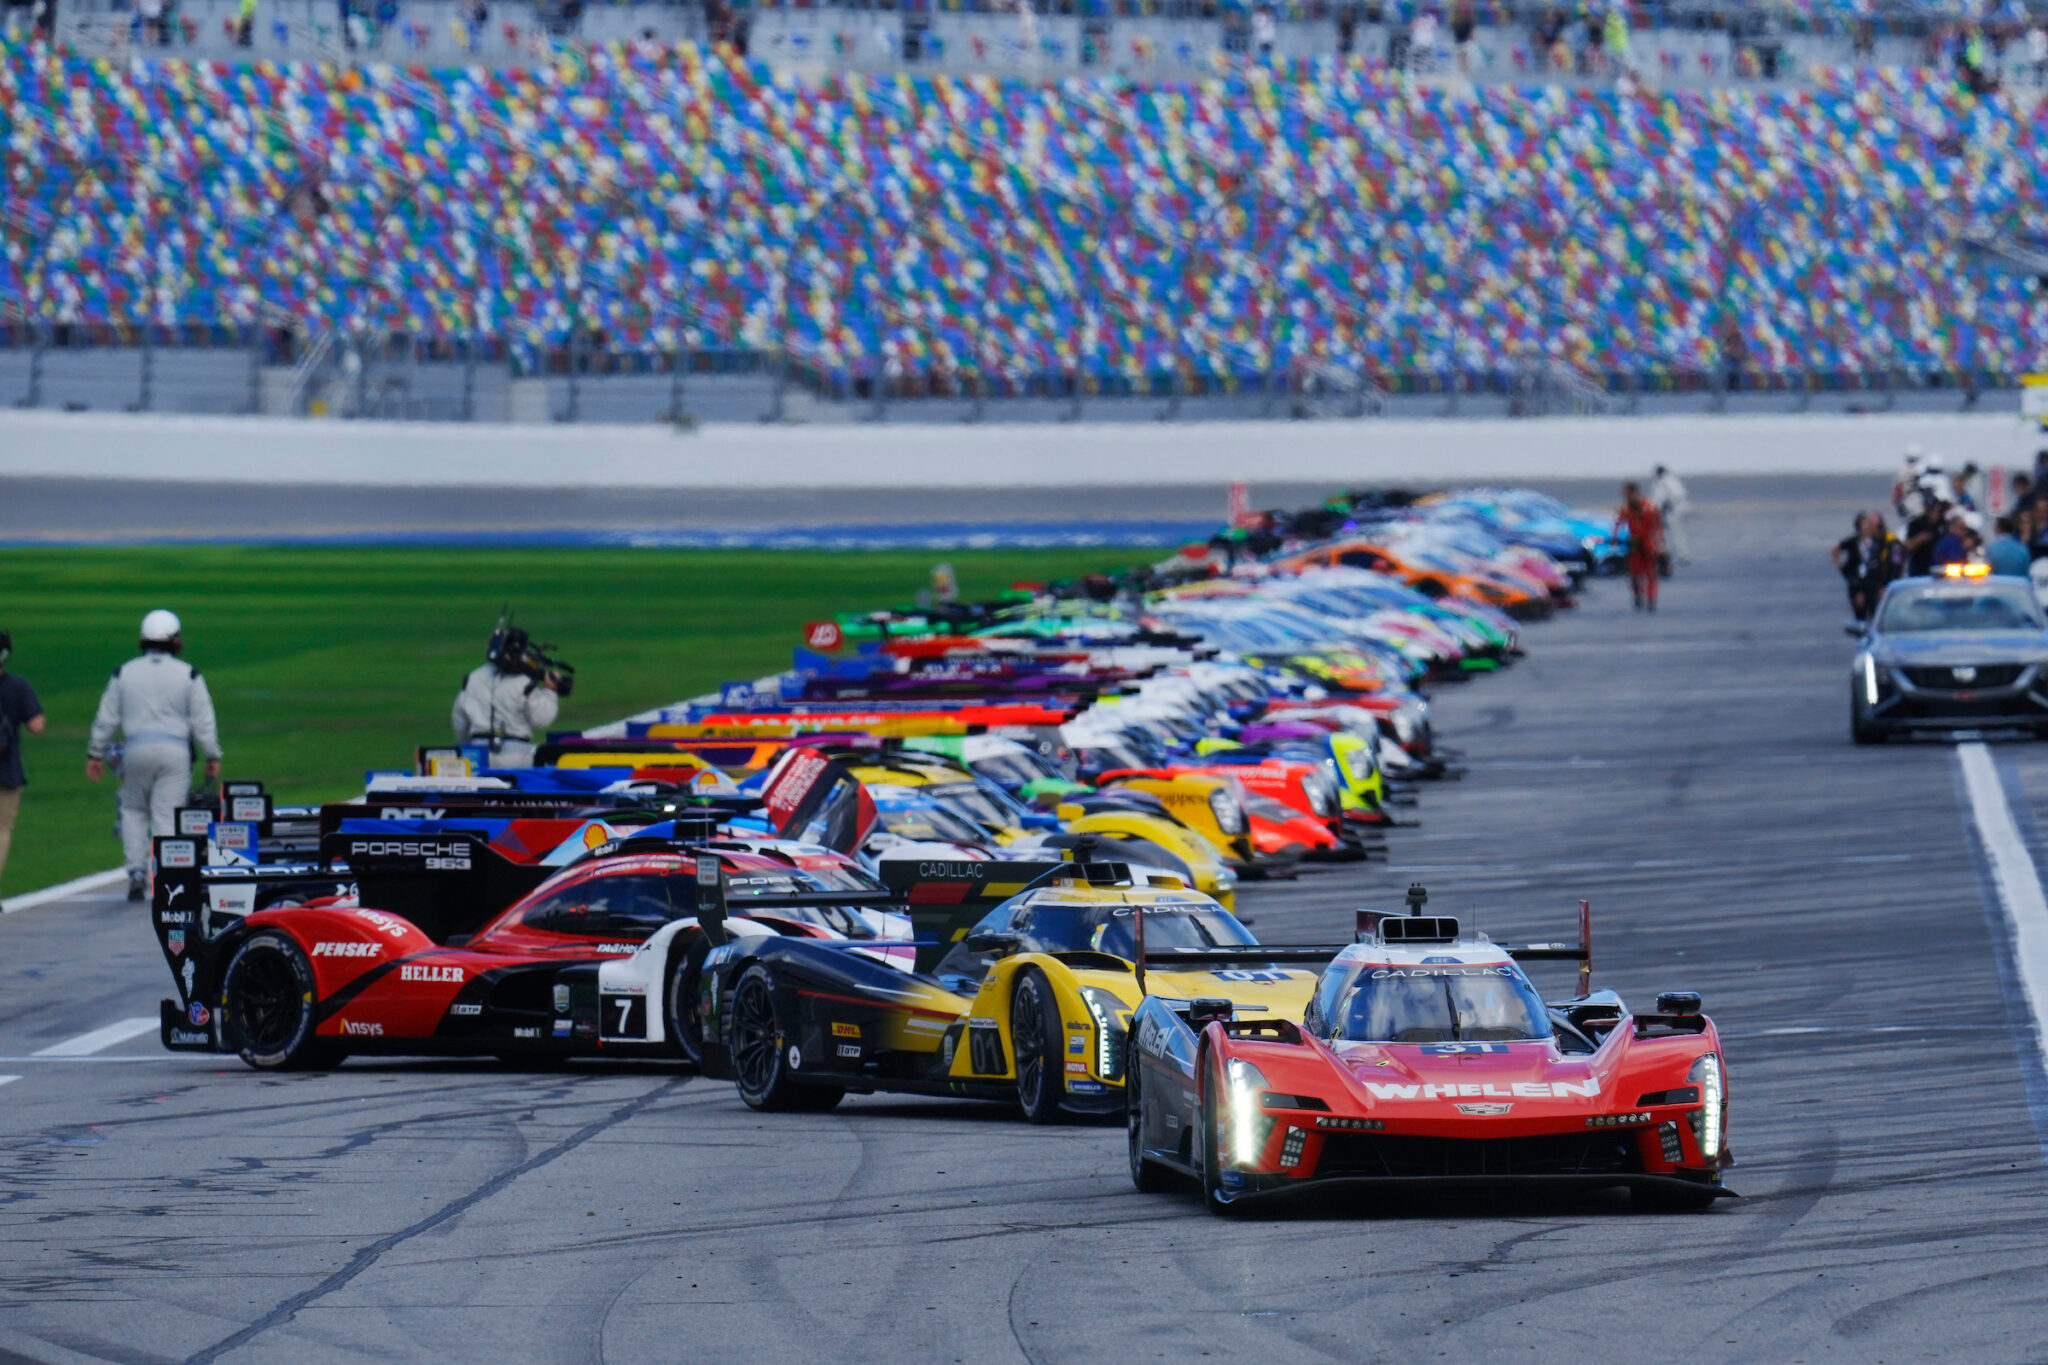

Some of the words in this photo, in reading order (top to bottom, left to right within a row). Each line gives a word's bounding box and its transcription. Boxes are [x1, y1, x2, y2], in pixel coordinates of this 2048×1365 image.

[352, 841, 471, 857] PORSCHE
[425, 857, 472, 870] 963
[919, 861, 984, 879] CADILLAC
[161, 910, 186, 924] Mobil
[311, 942, 384, 957] PENSKE
[400, 965, 465, 983] HELLER
[1370, 966, 1513, 980] CADILLAC
[615, 998, 632, 1034] 7
[339, 1017, 385, 1037] Ansys
[836, 1024, 859, 1036] DHL
[1138, 1008, 1170, 1060] WHELEN
[974, 1032, 1002, 1074] 01
[1066, 1062, 1087, 1072] MOTUL
[1074, 1083, 1102, 1091] MICHELIN
[1361, 1077, 1602, 1100] WHELEN
